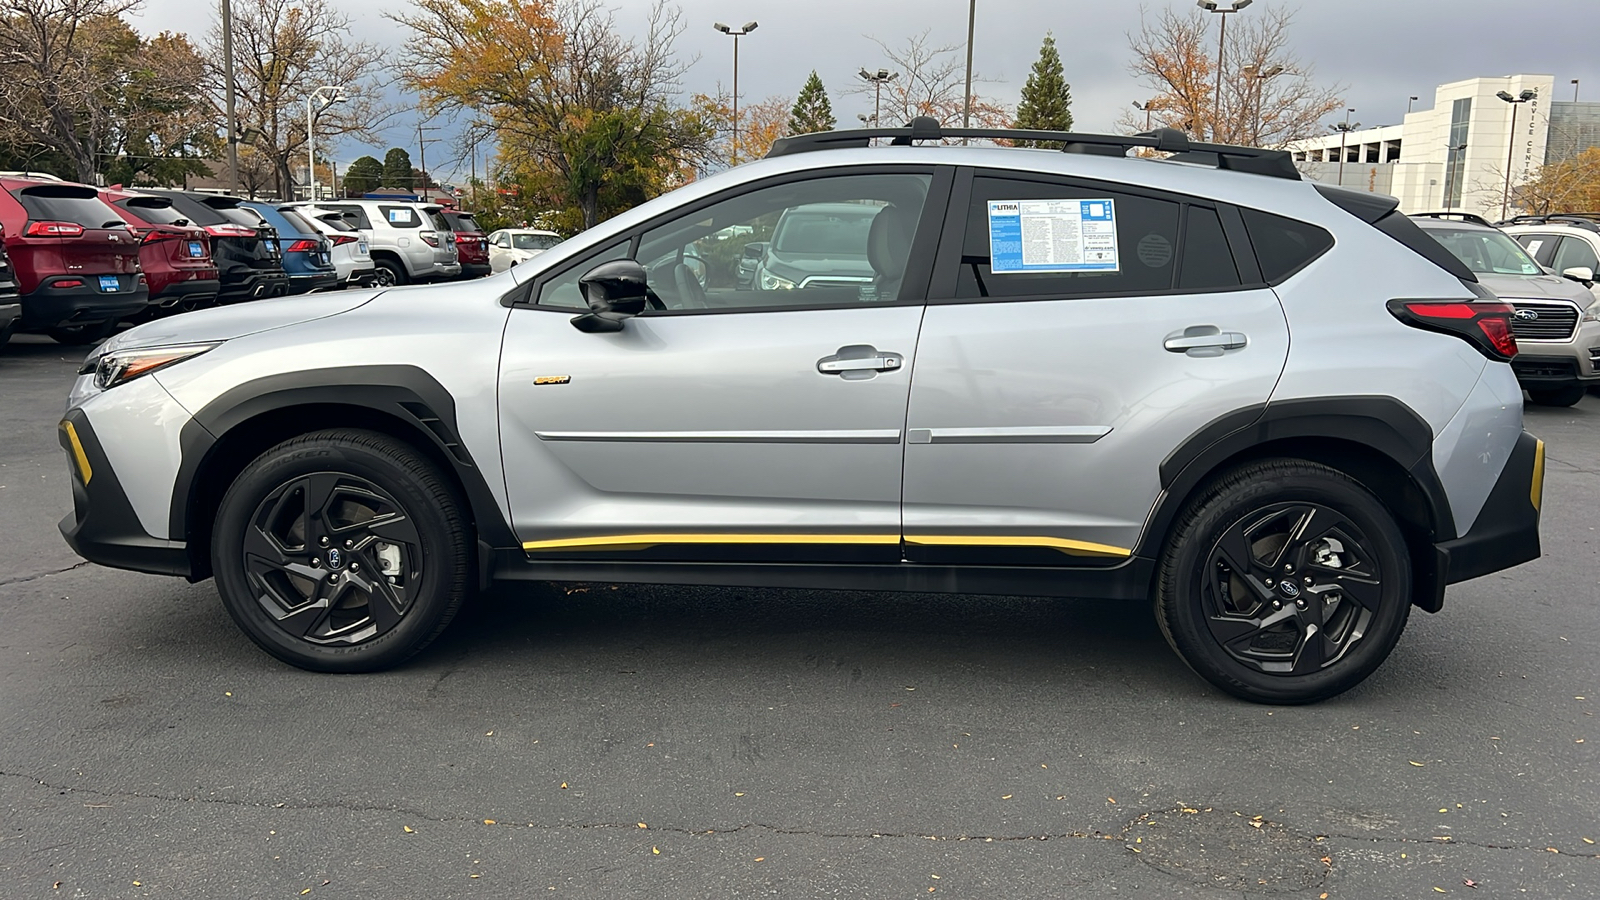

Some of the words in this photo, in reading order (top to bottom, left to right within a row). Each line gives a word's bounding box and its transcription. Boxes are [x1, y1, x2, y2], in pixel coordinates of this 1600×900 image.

[1529, 87, 1539, 135] SERVICE
[1523, 141, 1532, 181] CENTER
[536, 376, 567, 384] SPORT
